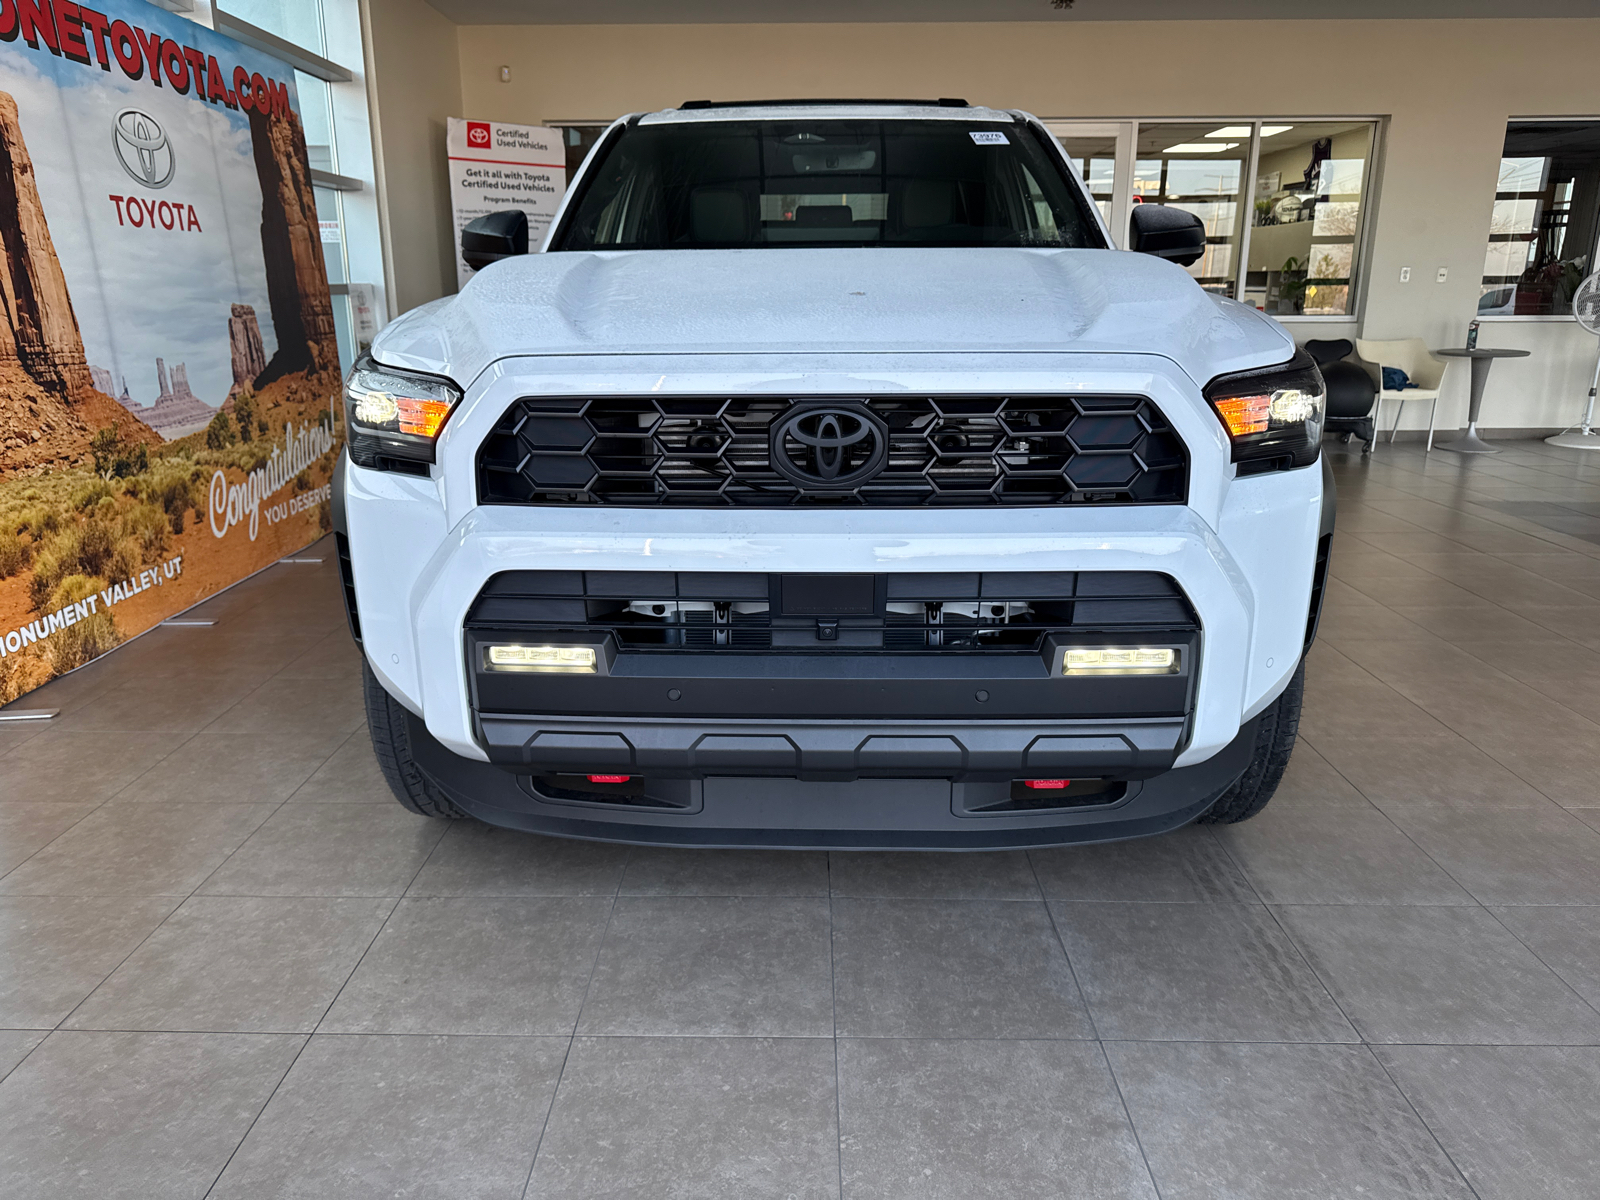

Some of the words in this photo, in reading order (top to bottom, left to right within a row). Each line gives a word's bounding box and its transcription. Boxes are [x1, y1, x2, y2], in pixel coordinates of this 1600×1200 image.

[496, 129, 530, 139] Certified
[496, 138, 517, 148] Used
[517, 140, 548, 151] Vehicles
[466, 168, 482, 177] Get
[483, 169, 490, 178] it
[491, 170, 502, 179] all
[503, 171, 522, 180] with
[523, 173, 550, 183] Toyota
[461, 179, 499, 189] Certified
[500, 181, 521, 191] Used
[522, 183, 555, 193] Vehicles
[483, 195, 511, 204] Program
[511, 197, 537, 205] Benefits
[109, 194, 203, 233] TOYOTA
[209, 394, 337, 541] Congratulations!
[264, 502, 288, 526] YOU
[289, 484, 332, 515] DESERVE
[100, 566, 163, 607] VALLEY,
[163, 556, 182, 579] UT
